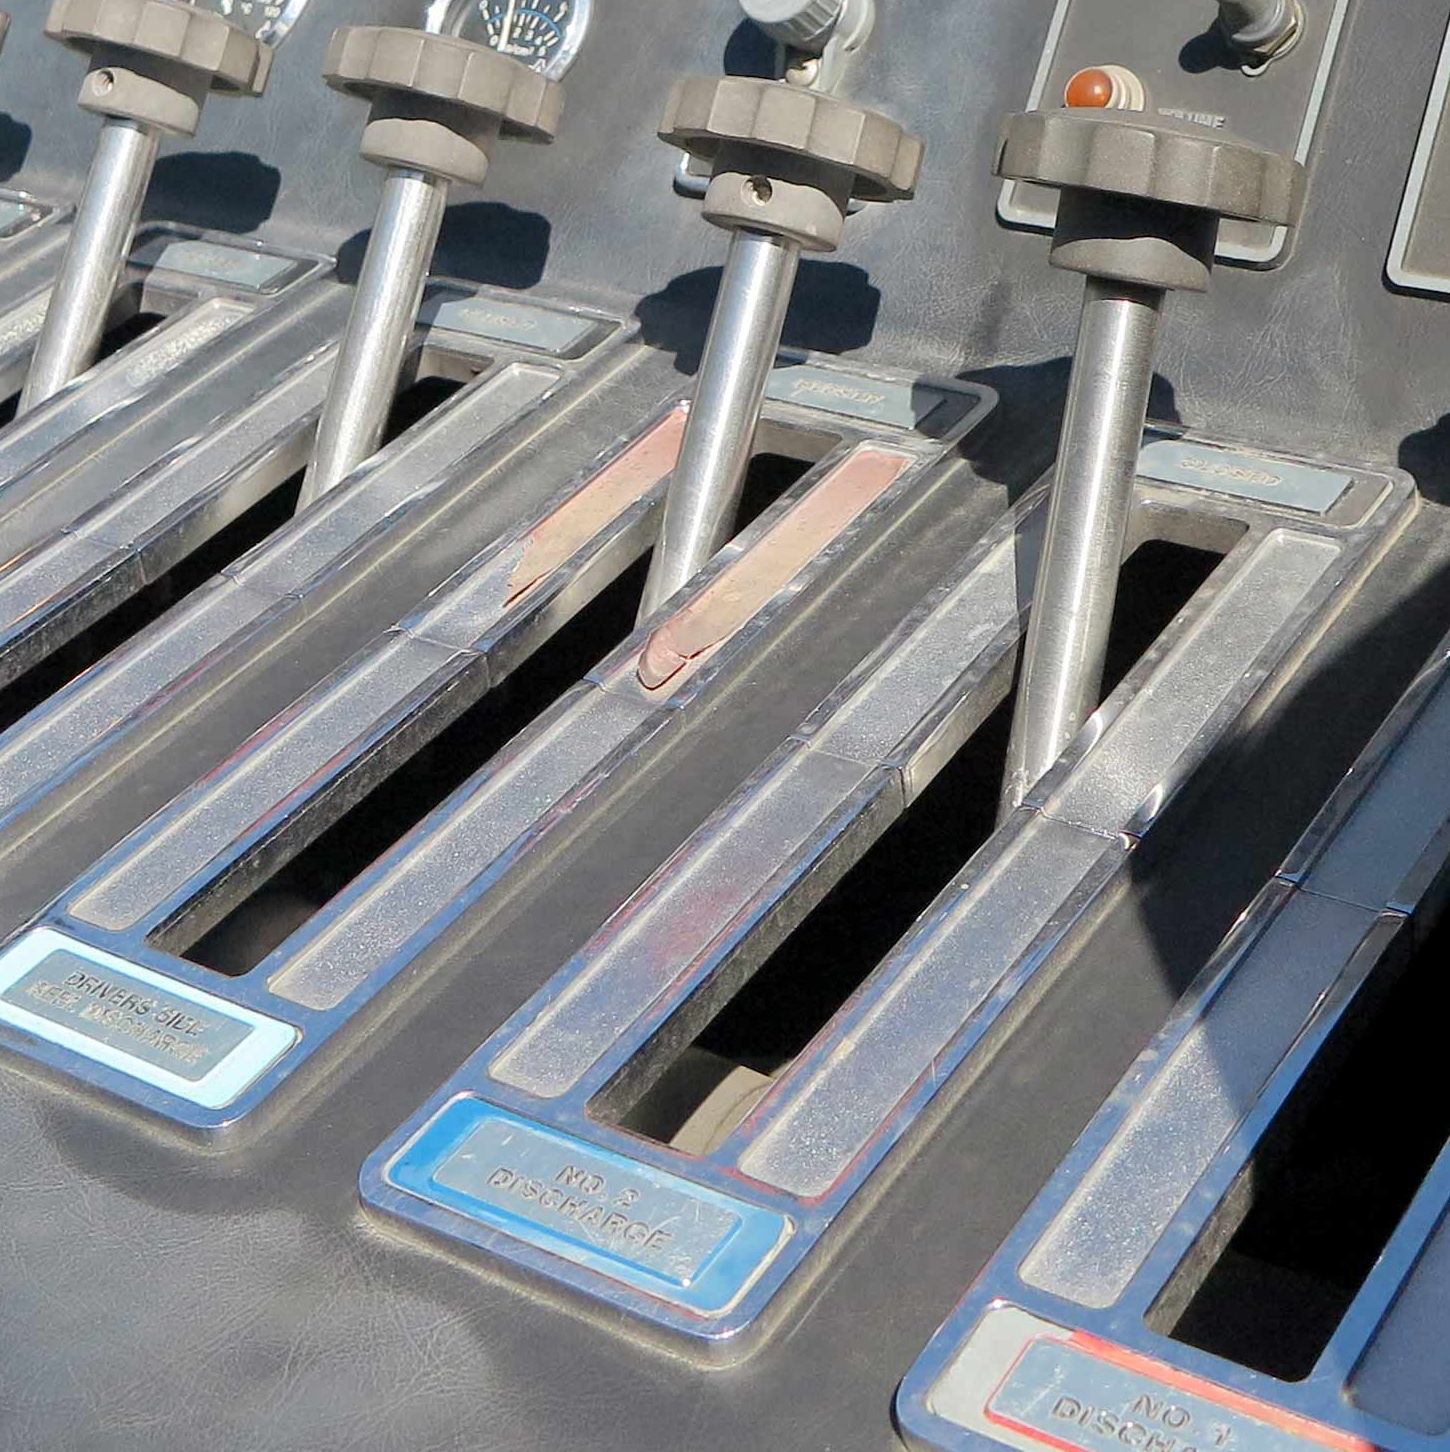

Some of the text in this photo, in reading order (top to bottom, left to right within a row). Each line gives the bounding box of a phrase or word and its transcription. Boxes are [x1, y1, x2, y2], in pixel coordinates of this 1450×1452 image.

[1179, 458, 1285, 487] CLOSED
[62, 969, 207, 1038] DRIVERS SIDE
[78, 1001, 210, 1065] DISCHARGE
[485, 1166, 677, 1251] DISCHARGE
[553, 1163, 644, 1209] NO. 2
[1130, 1392, 1207, 1433] NO.
